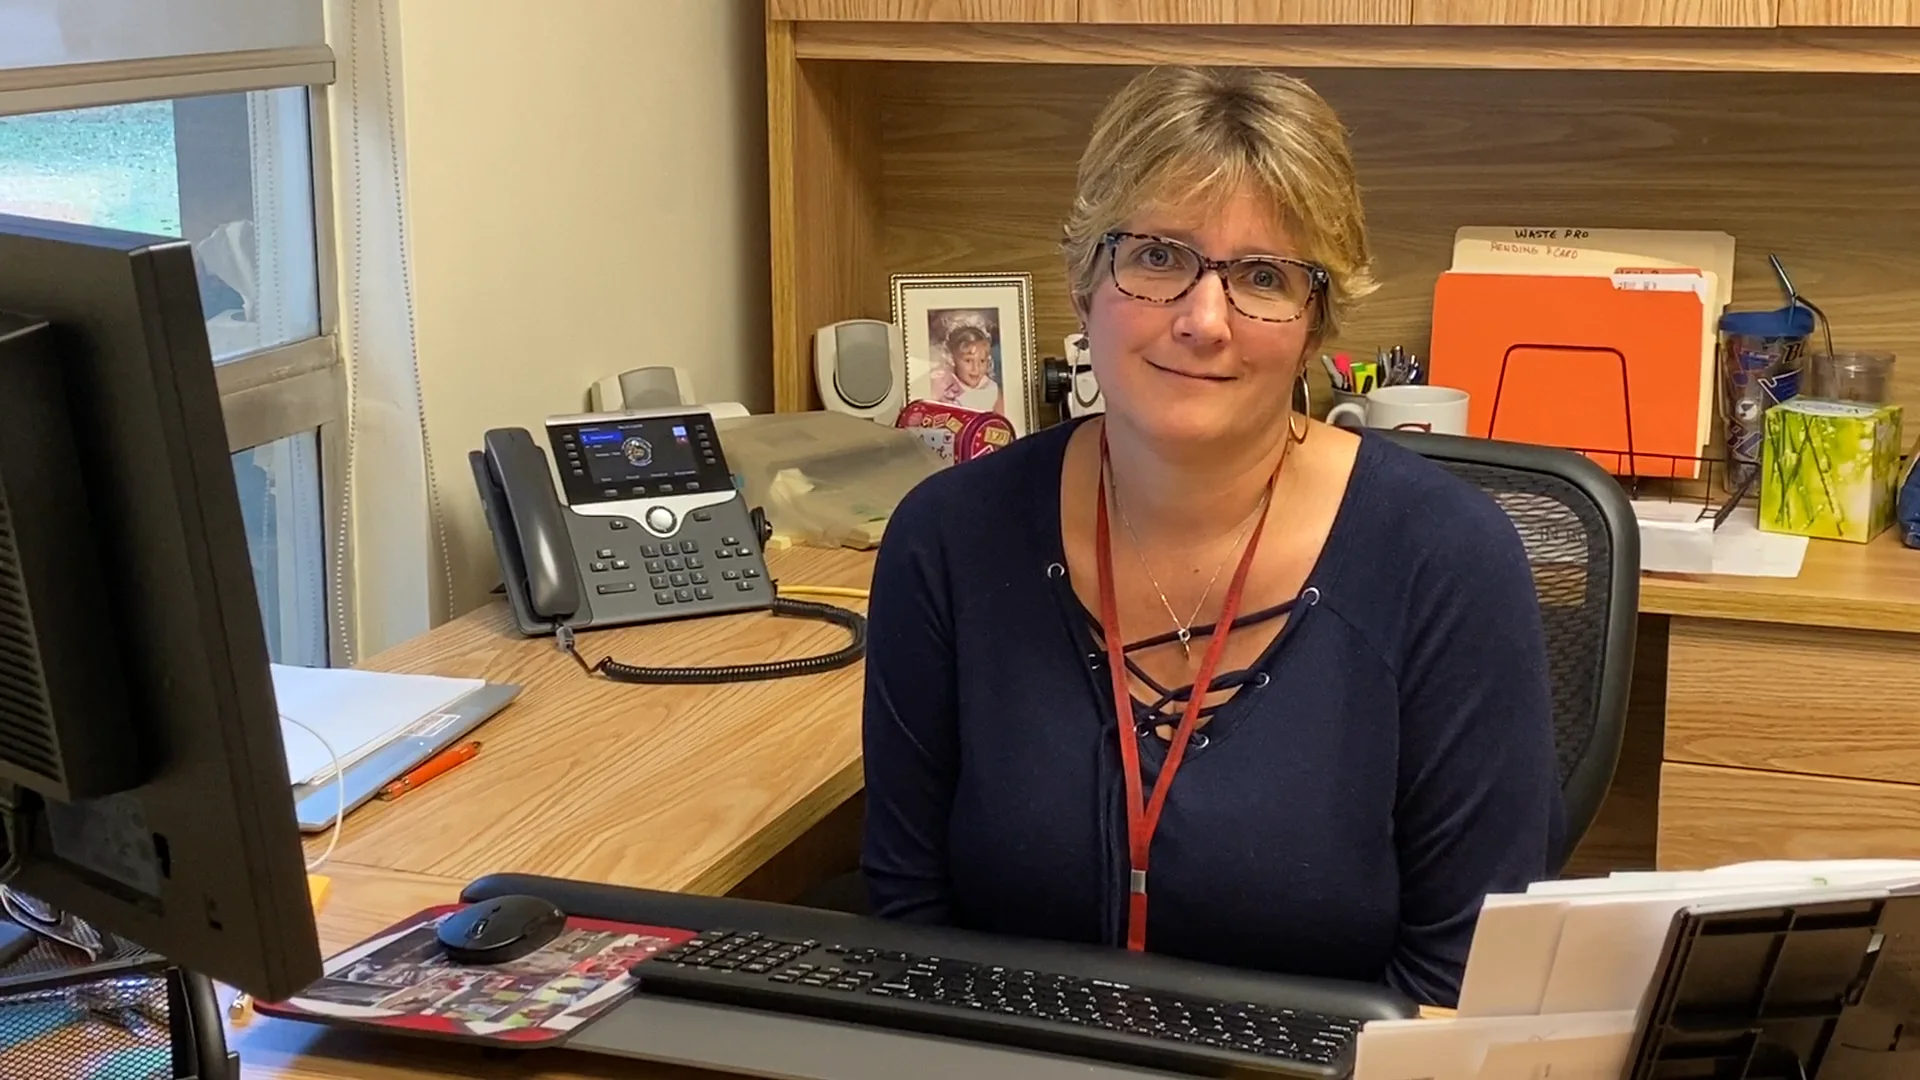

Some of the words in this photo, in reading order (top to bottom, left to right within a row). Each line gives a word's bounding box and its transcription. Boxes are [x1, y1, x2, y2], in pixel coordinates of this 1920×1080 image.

[1514, 228, 1557, 239] WASTE
[1564, 229, 1589, 239] PRO
[1490, 240, 1539, 255] PENDING
